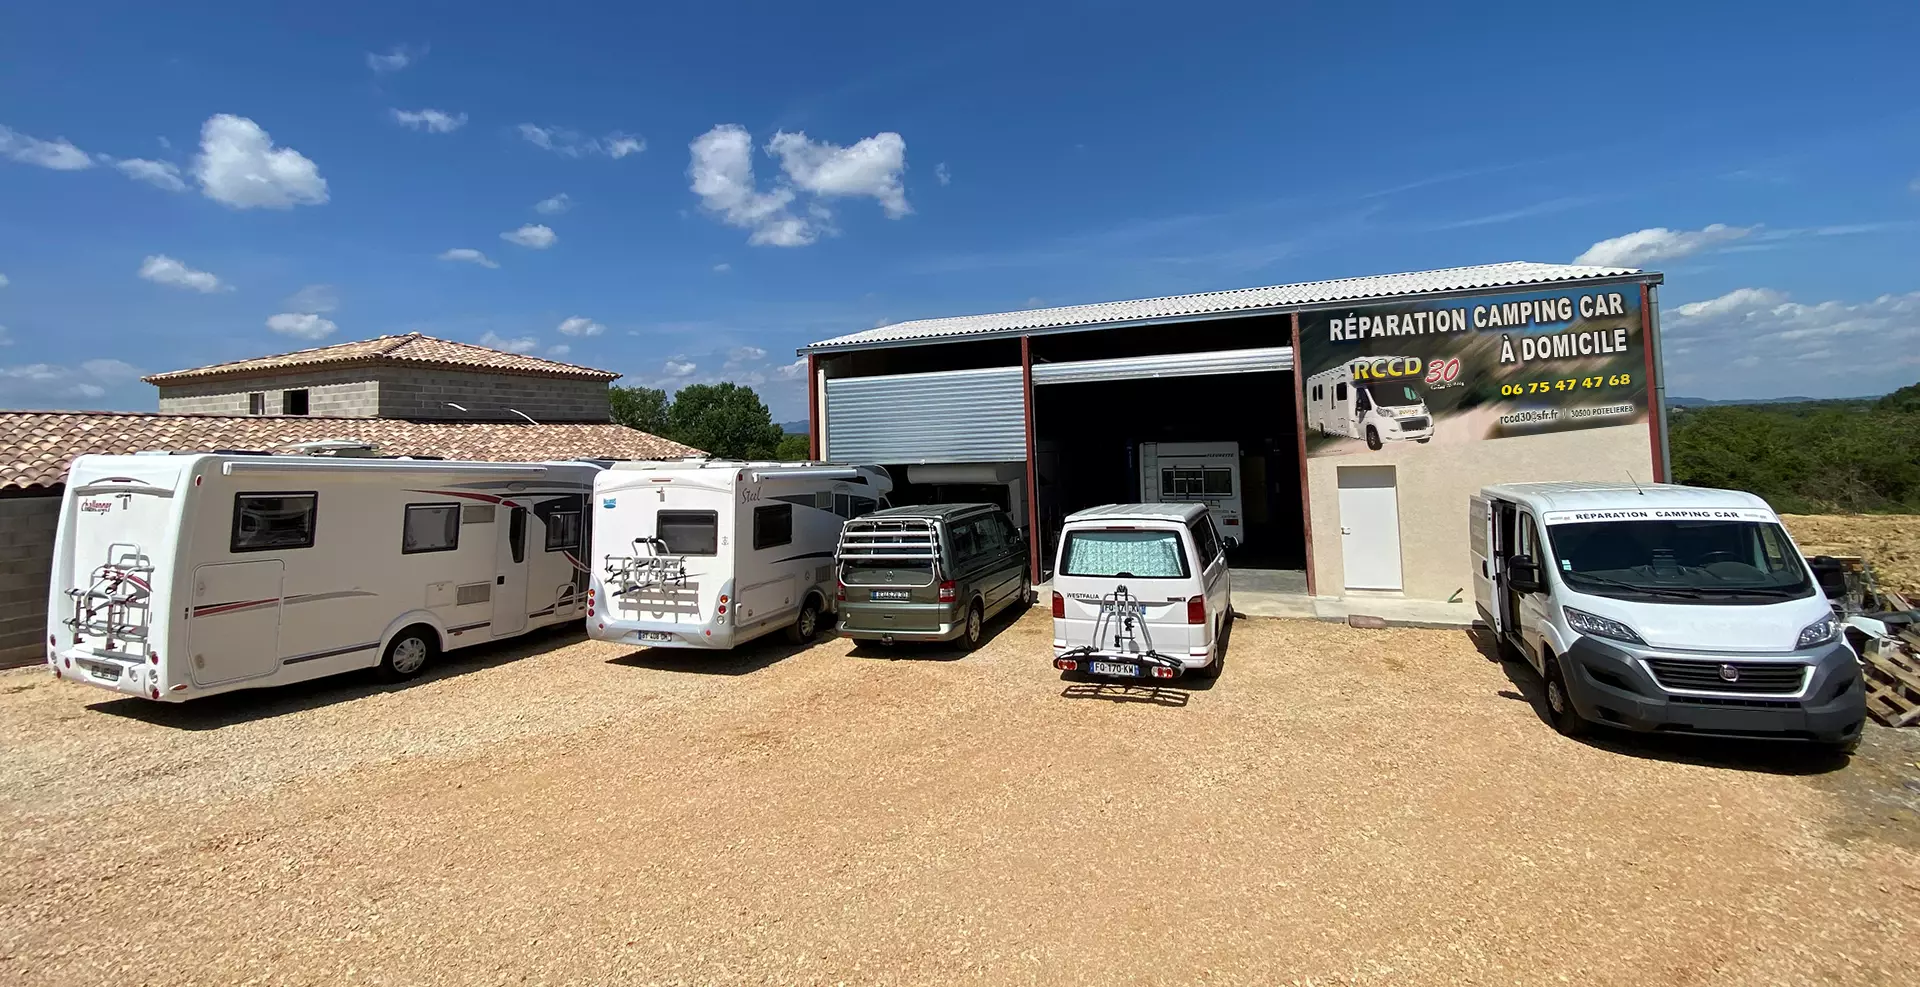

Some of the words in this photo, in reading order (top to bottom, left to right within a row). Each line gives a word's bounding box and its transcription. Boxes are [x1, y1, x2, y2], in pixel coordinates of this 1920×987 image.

[1329, 308, 1466, 341] RÉPARATION
[1473, 297, 1573, 328] CAMPING
[1579, 293, 1624, 318] CAR
[1500, 335, 1515, 363] À
[1522, 329, 1627, 361] DOMICILE
[1354, 357, 1422, 379] RCCD
[1425, 358, 1460, 383] 30
[1501, 384, 1524, 396] 06
[1528, 381, 1550, 394] 75
[1555, 379, 1577, 391] 47
[1582, 376, 1604, 389] 47
[1608, 374, 1631, 386] 68
[1714, 511, 1740, 519] CAR
[1066, 592, 1100, 600] WESTFALIA
